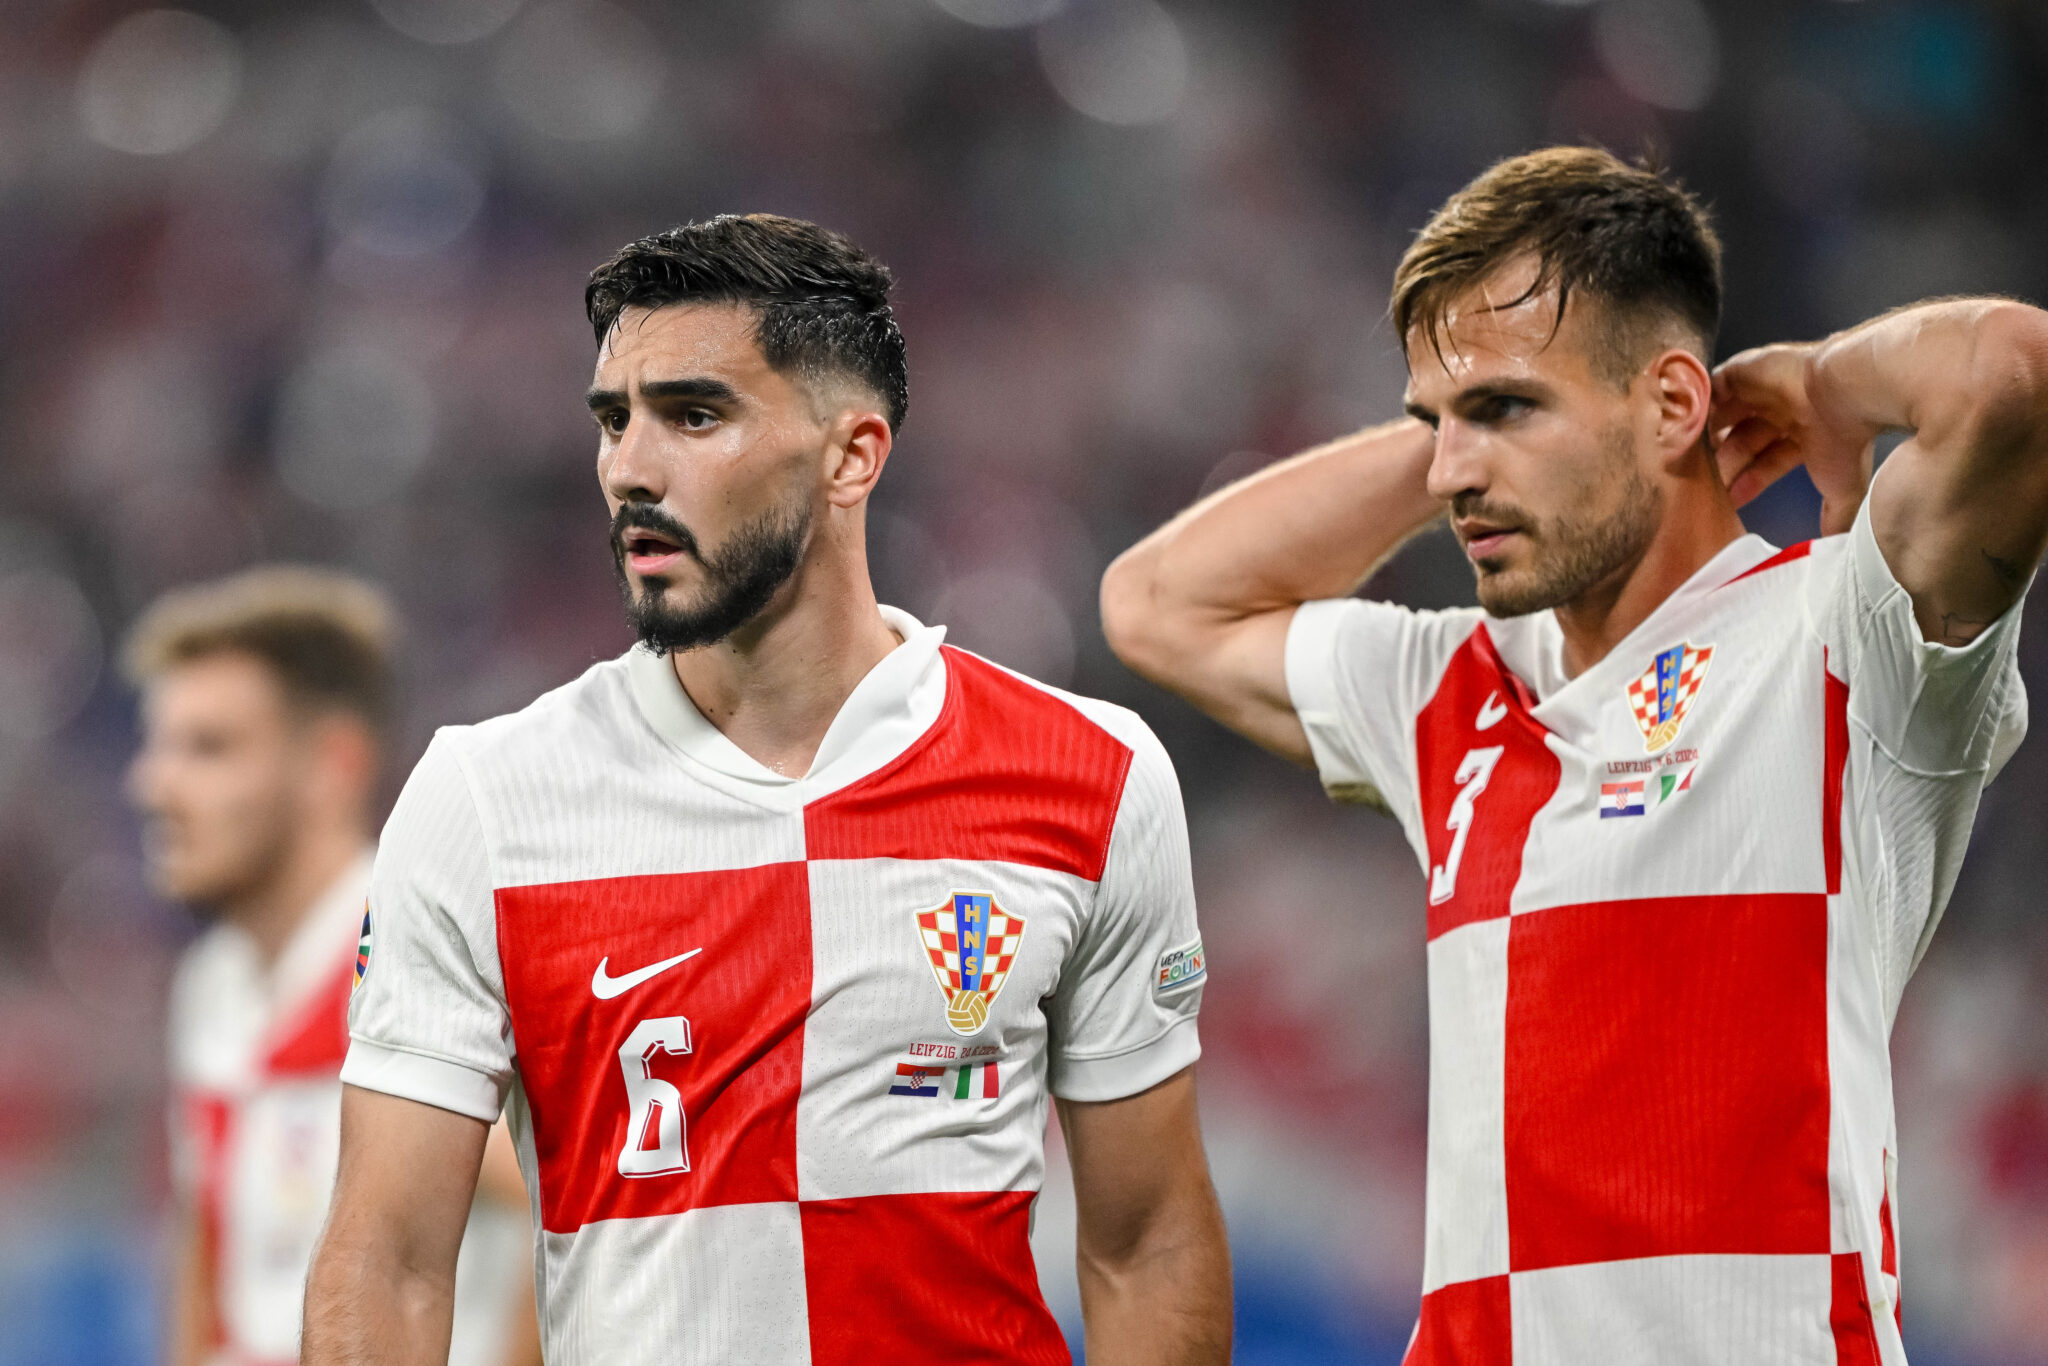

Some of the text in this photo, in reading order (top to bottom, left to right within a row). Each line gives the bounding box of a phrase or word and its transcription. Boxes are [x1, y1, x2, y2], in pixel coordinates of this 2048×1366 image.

[1431, 745, 1504, 906] 3
[964, 904, 981, 976] HNS
[1160, 953, 1204, 985] FOUN
[1161, 951, 1184, 967] UEFA
[618, 1016, 692, 1178] 6
